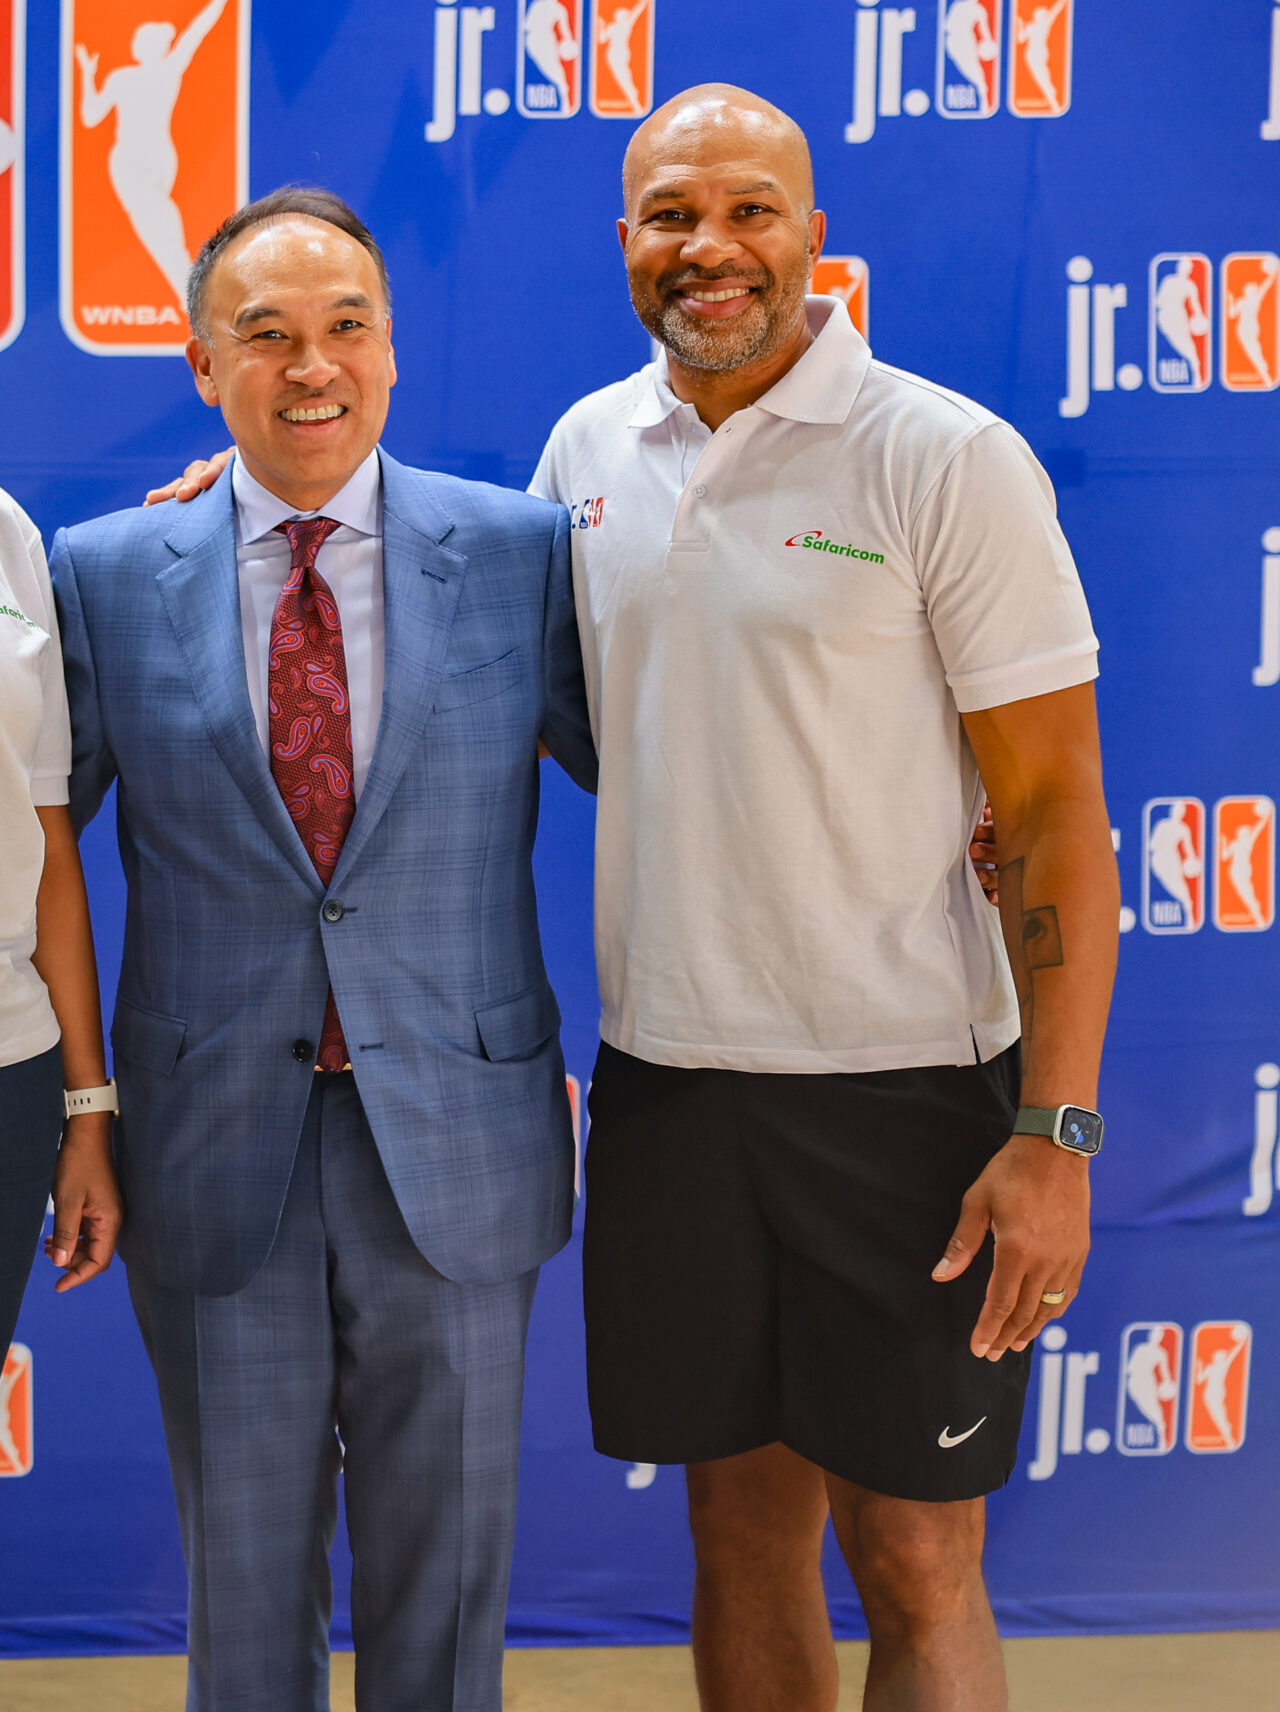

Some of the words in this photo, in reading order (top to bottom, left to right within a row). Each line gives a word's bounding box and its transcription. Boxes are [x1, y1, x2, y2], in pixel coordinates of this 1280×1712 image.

[424, 0, 510, 142] jr.
[844, 0, 930, 144] jr.
[81, 305, 181, 325] WNBA
[1059, 255, 1143, 418] jr.
[802, 536, 885, 565] Safaricom
[1027, 1325, 1111, 1481] jr.
